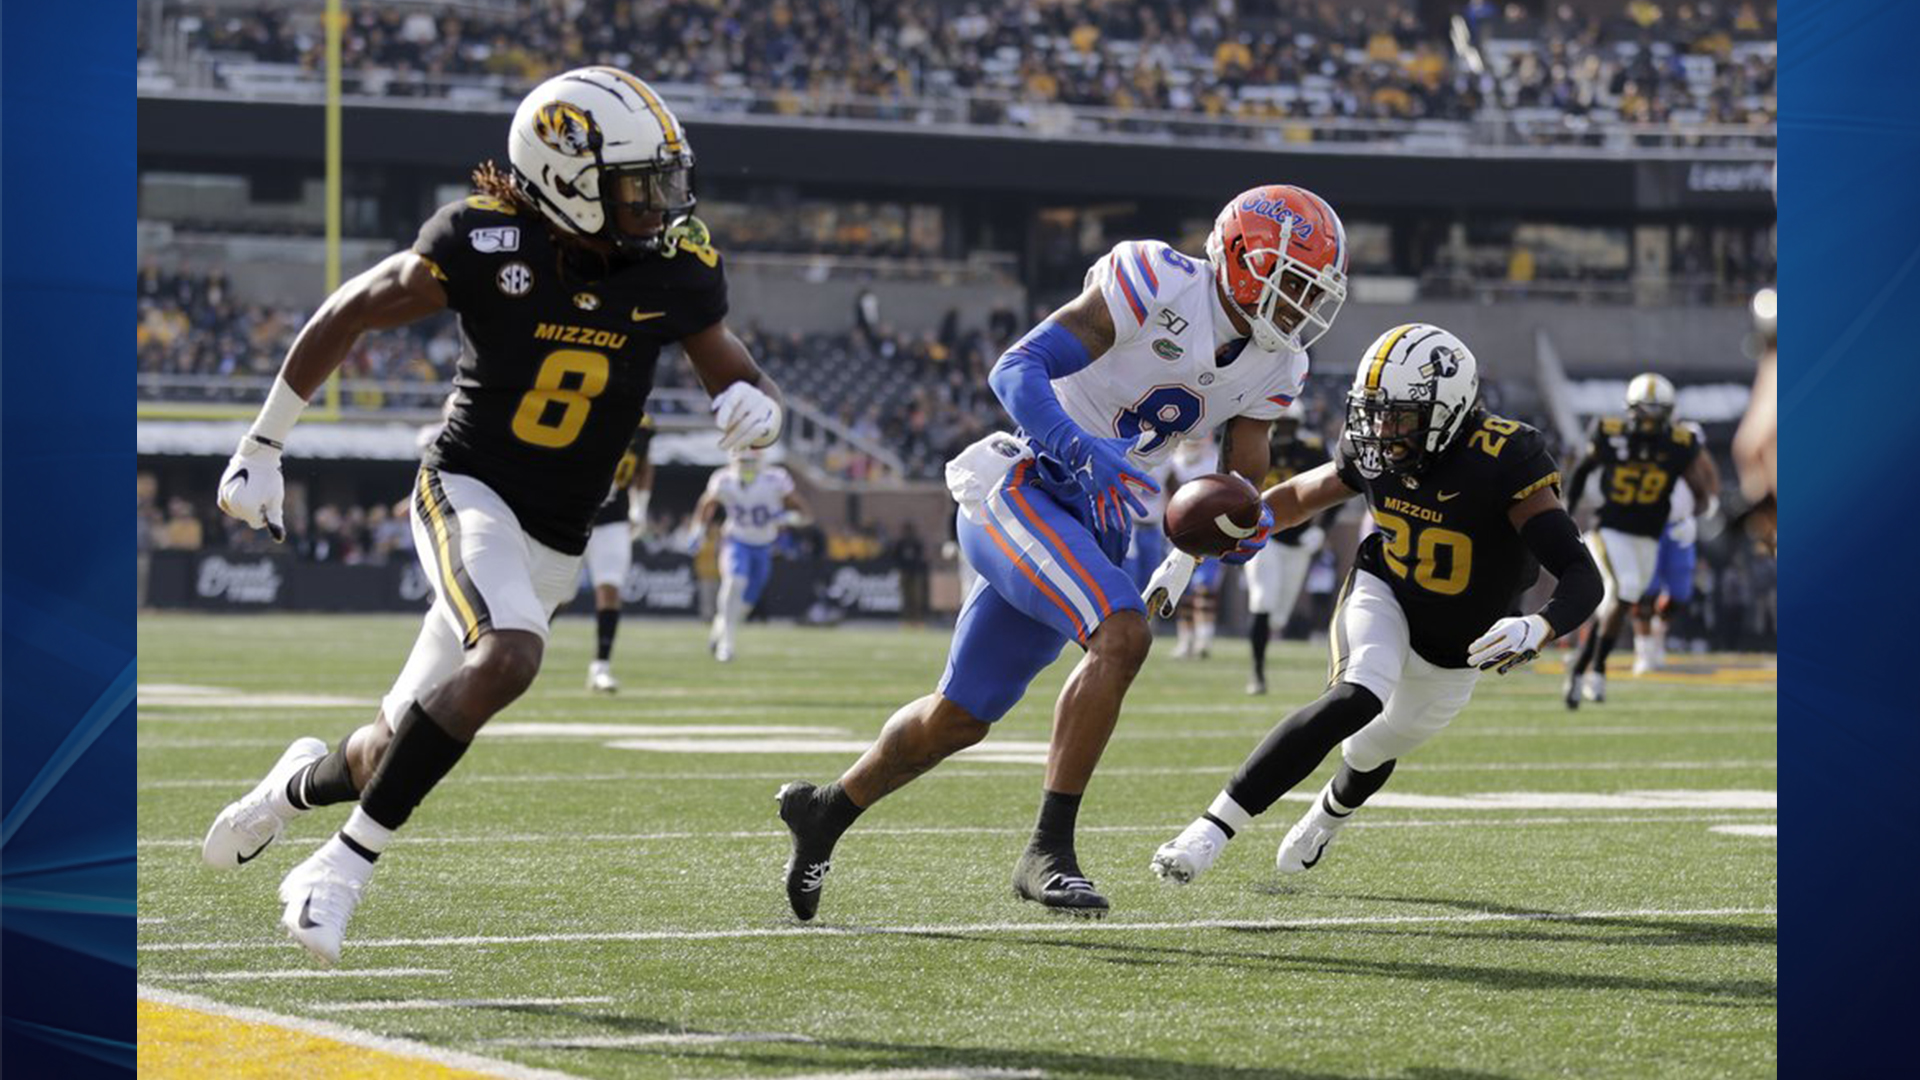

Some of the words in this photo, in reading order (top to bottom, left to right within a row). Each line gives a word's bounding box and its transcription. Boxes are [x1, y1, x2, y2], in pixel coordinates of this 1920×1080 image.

[501, 265, 529, 294] SEC
[534, 322, 627, 349] MIZZOU
[511, 349, 610, 448] 8
[1112, 384, 1205, 456] 8
[1467, 416, 1521, 458] 20
[1384, 496, 1443, 524] MIZZOU
[1374, 511, 1472, 595] 20
